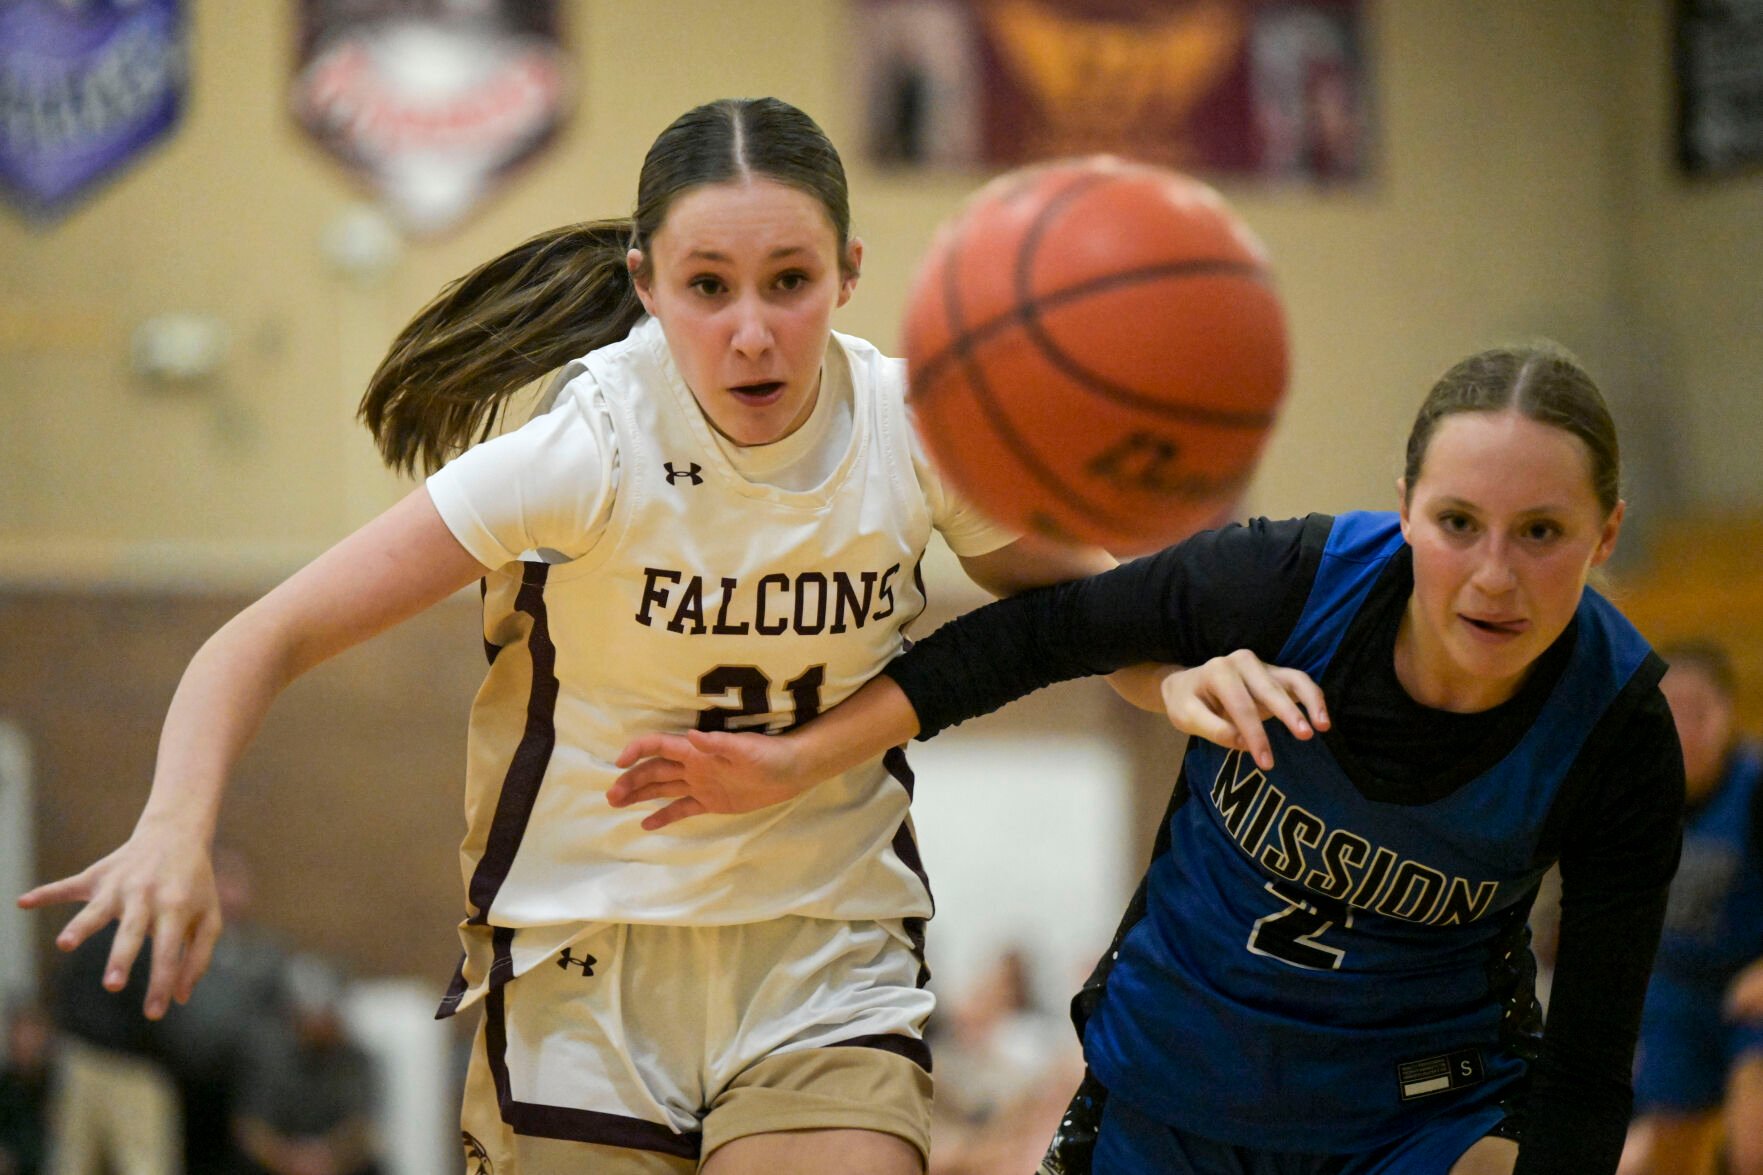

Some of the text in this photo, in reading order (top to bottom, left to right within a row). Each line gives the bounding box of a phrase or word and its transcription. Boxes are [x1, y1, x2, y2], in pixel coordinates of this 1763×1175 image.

[635, 563, 900, 635] FALCONS
[696, 663, 827, 733] 21
[1210, 748, 1499, 925] MISSION
[1247, 881, 1353, 970] 2
[1460, 1060, 1473, 1077] S
